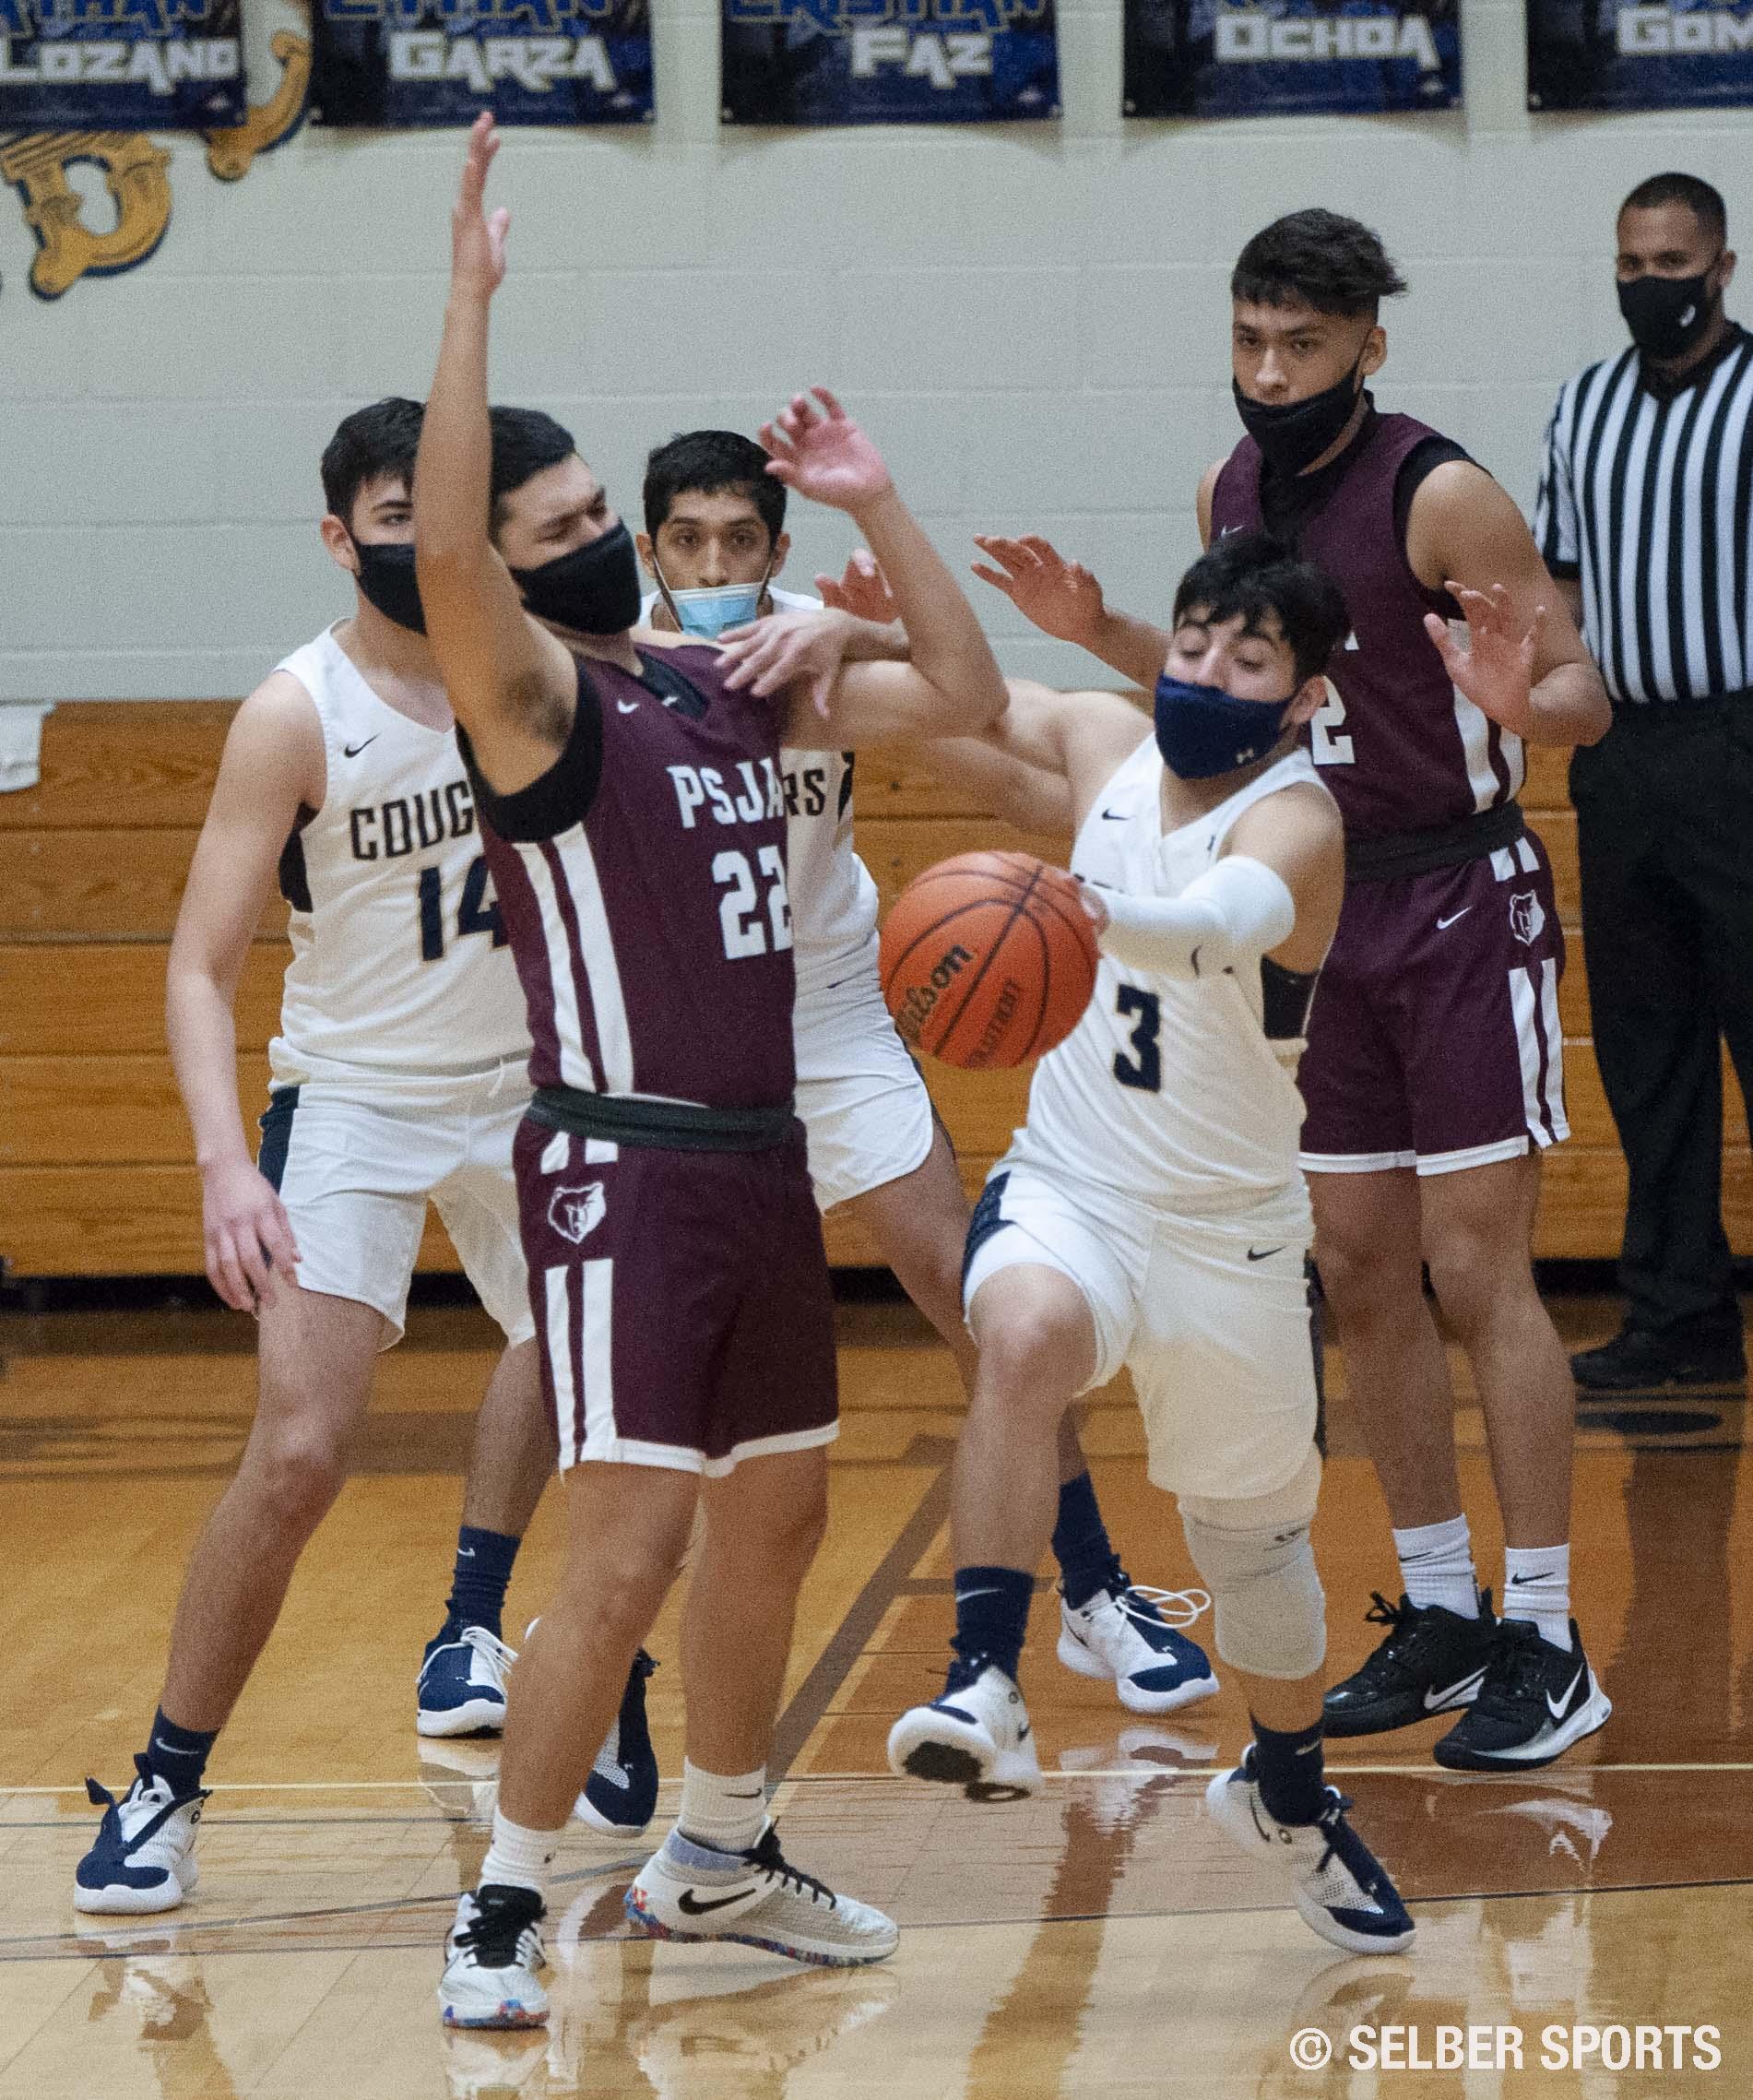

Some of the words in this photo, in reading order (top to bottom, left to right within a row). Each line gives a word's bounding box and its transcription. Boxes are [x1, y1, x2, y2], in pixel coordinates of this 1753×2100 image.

[0, 33, 240, 96] LOZANO
[388, 30, 616, 92] GARZA
[849, 25, 993, 89] FAZ
[1214, 13, 1441, 71] OCHOA
[418, 854, 510, 962] 14
[1113, 983, 1162, 1094] 3
